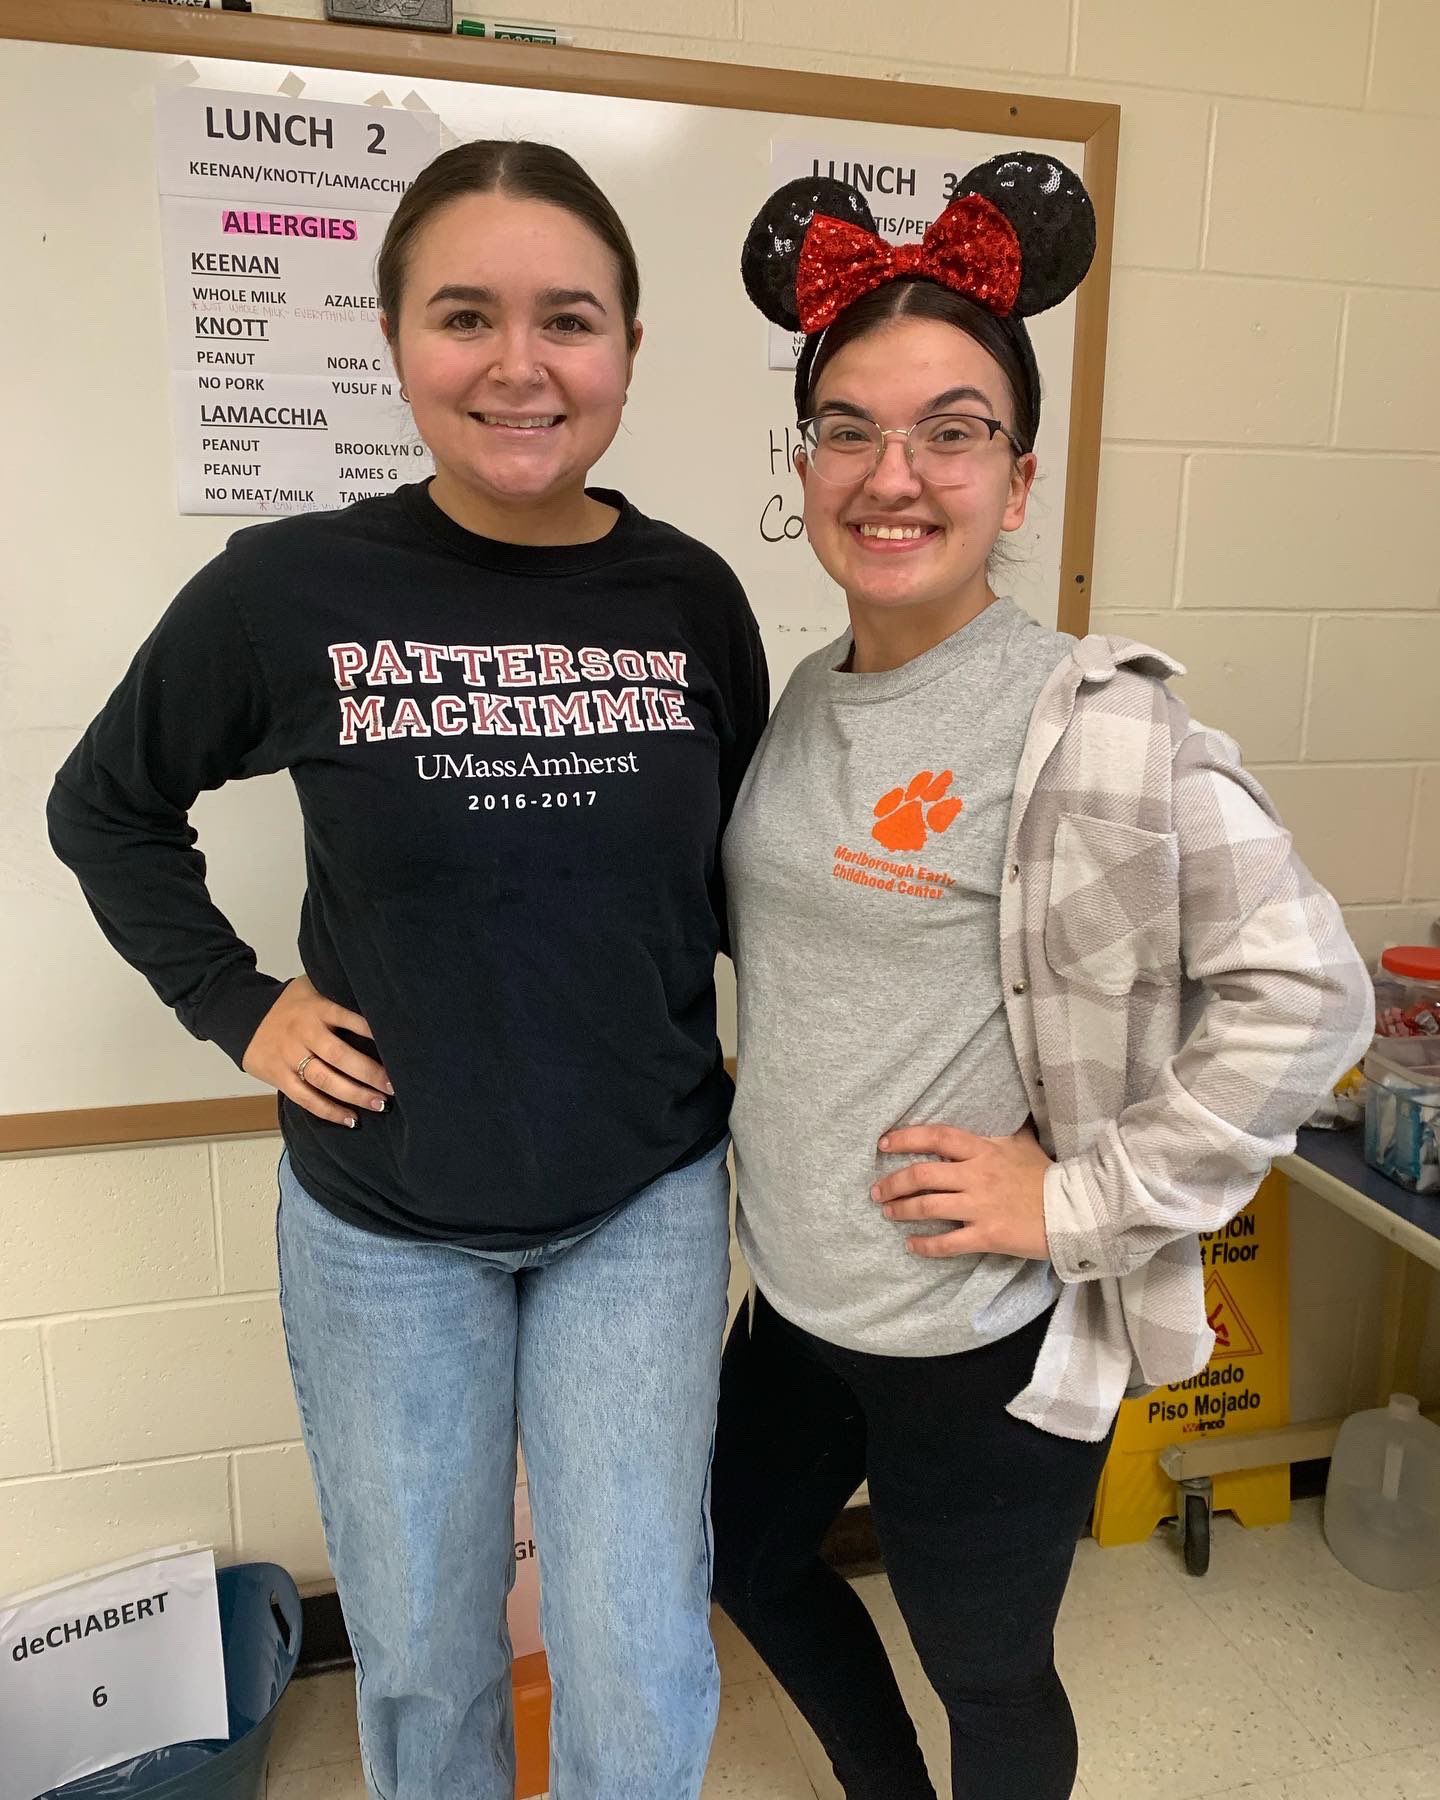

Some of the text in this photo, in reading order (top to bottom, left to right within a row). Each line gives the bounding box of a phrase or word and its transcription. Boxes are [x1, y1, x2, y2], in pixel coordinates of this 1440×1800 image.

[205, 106, 387, 155] LUNCH 2
[942, 172, 958, 200] 3
[222, 210, 358, 241] ALLERGIES
[191, 252, 280, 275] KEENAN
[192, 287, 287, 304] WHOLE MILK
[195, 316, 269, 337] KNOTT
[197, 351, 256, 366] PEANUT
[327, 356, 381, 371] NORA C
[199, 376, 265, 391] NO PORK
[332, 381, 392, 396] YUSUF N
[200, 404, 328, 426] LAMACCHIA
[202, 438, 260, 452] PEANUT
[335, 442, 424, 457] BROOKLYN O
[203, 463, 261, 477] PEANUT
[339, 467, 398, 480] JAMES G
[205, 487, 315, 503] NO MEAT/MILK
[759, 494, 805, 542] Co
[327, 640, 689, 691] PATTERSON
[339, 687, 695, 745] MACKIMMIE
[468, 791, 597, 811] 2016-2017
[834, 845, 914, 878] Marlborough
[832, 863, 945, 900] Childhood Center
[1211, 1241, 1260, 1265] Floor
[1148, 1388, 1262, 1424] Piso Mojado
[11, 1591, 170, 1662] deCHABERT
[92, 1685, 109, 1708] 6
